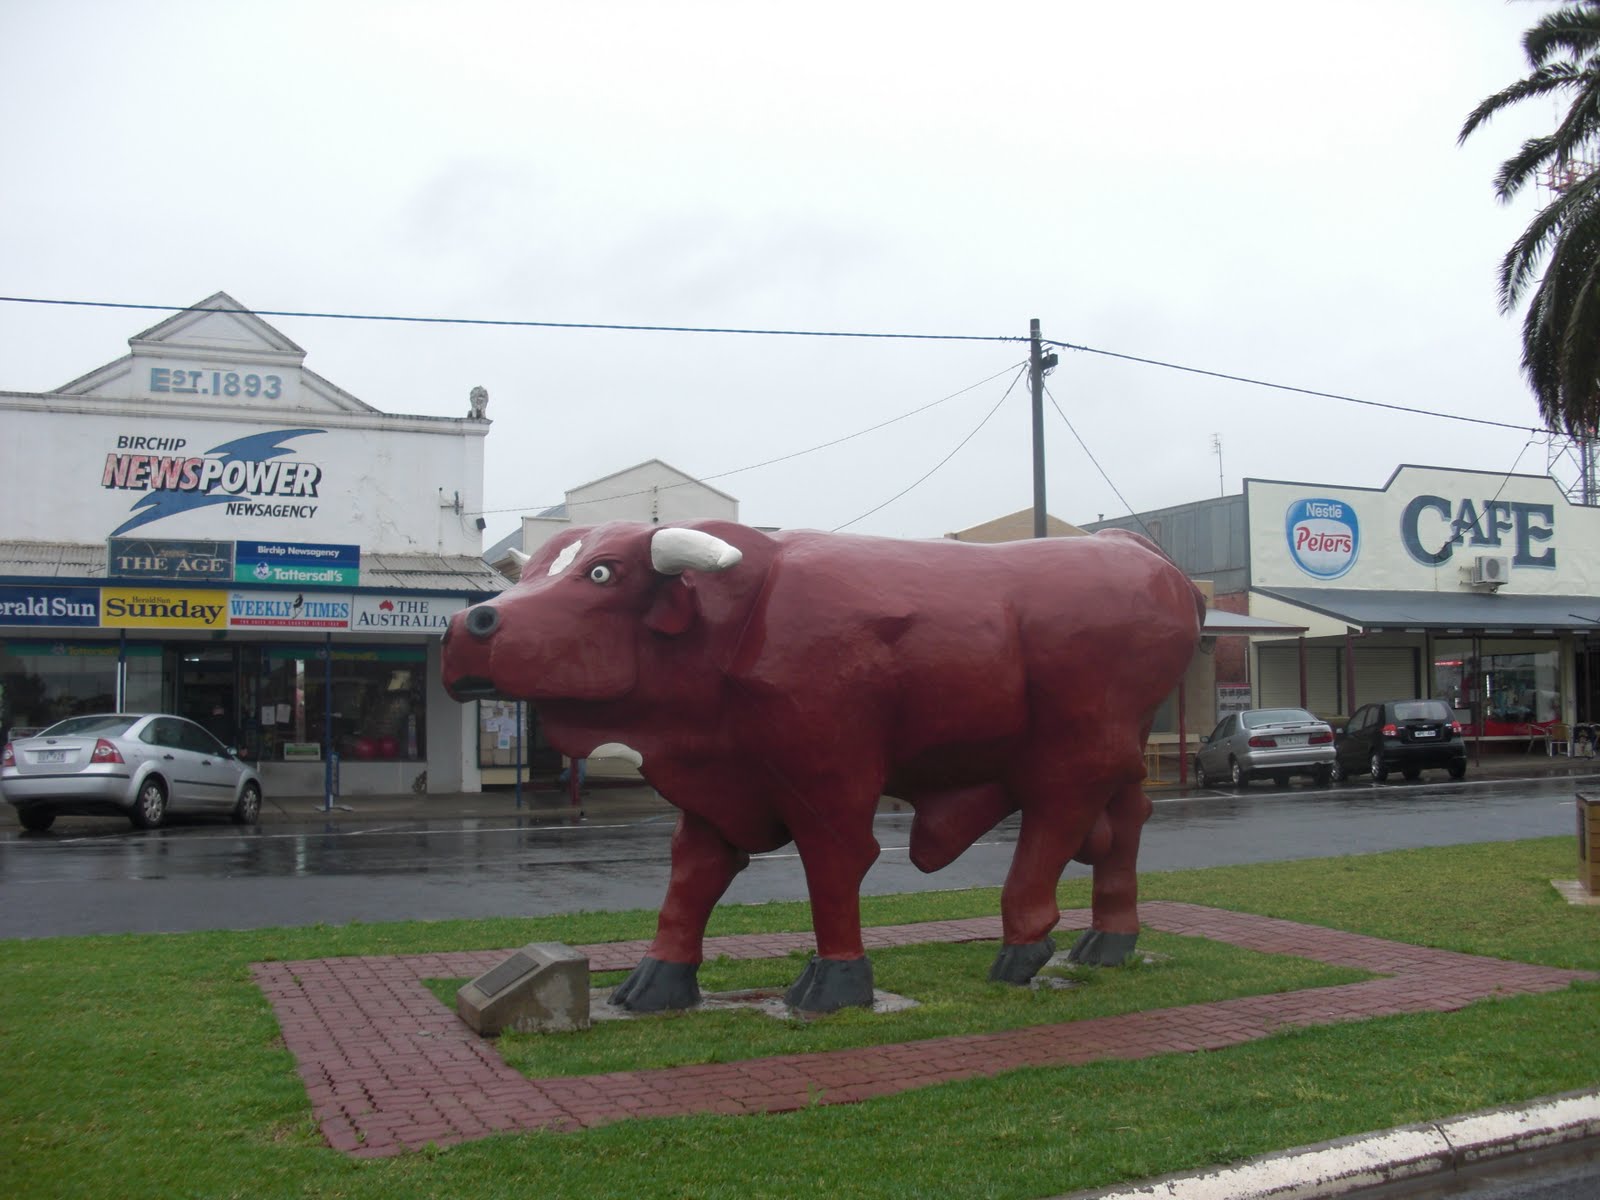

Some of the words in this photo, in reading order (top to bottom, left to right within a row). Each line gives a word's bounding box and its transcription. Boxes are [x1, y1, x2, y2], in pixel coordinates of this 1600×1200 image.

[117, 435, 187, 451] BIRCHIP
[226, 502, 318, 519] NEWSAGENCY
[1296, 526, 1352, 553] Peters
[1401, 494, 1556, 570] CAFE
[257, 545, 286, 556] Birchip
[287, 547, 340, 558] Newsagency
[117, 556, 168, 570] THE
[176, 558, 225, 572] AGE
[273, 568, 343, 582] Tattersall's
[51, 597, 96, 617] Sun
[106, 597, 225, 625] Sunday
[231, 600, 292, 617] WEEKLY
[304, 602, 349, 618] TIMES
[397, 600, 429, 614] THE
[357, 611, 449, 628] AUSTRALIA
